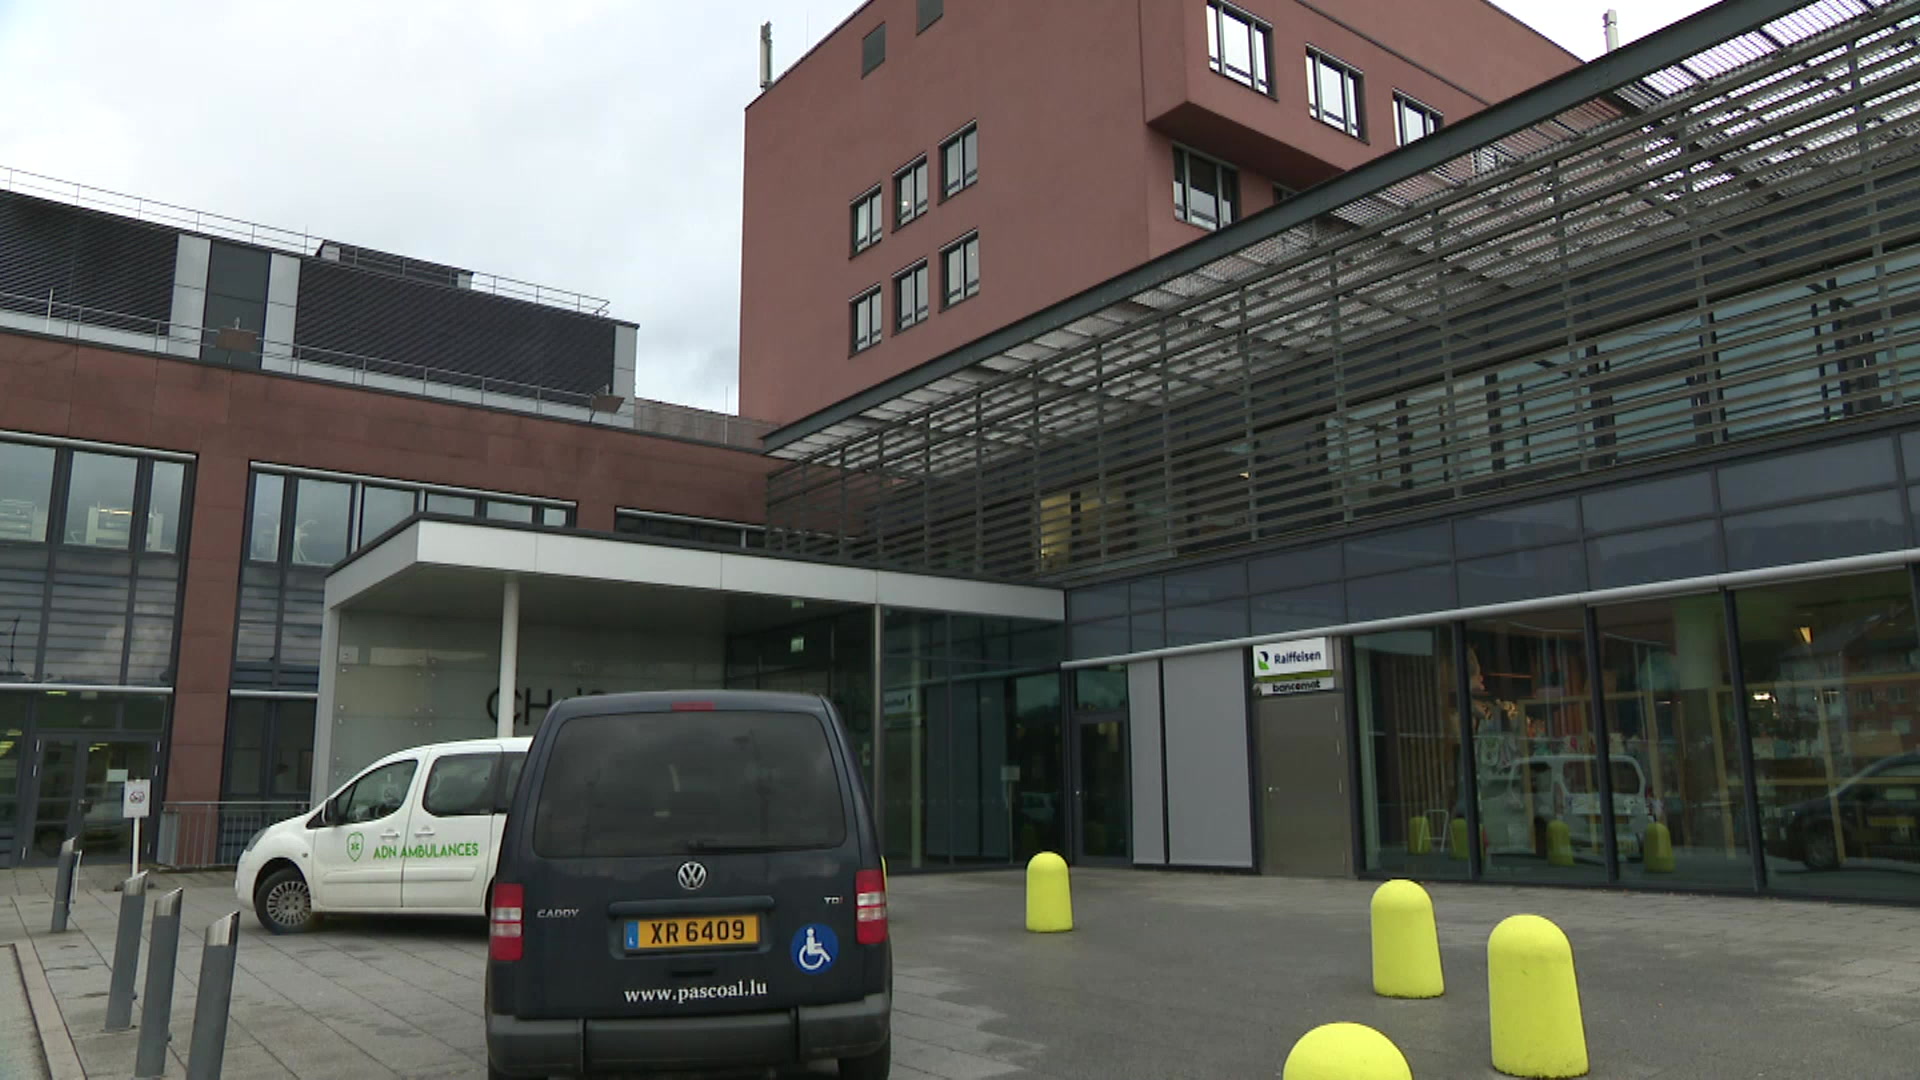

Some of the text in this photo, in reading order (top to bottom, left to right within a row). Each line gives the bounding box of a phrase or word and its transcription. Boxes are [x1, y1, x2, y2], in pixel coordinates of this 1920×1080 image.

[1274, 651, 1321, 664] Raiffeisen
[1272, 681, 1320, 692] bancomat
[373, 843, 479, 859] ADN AMBULANCES
[537, 908, 579, 918] CADDY
[651, 919, 745, 944] XR 6409
[624, 979, 768, 1004] www.pascoal.lu
